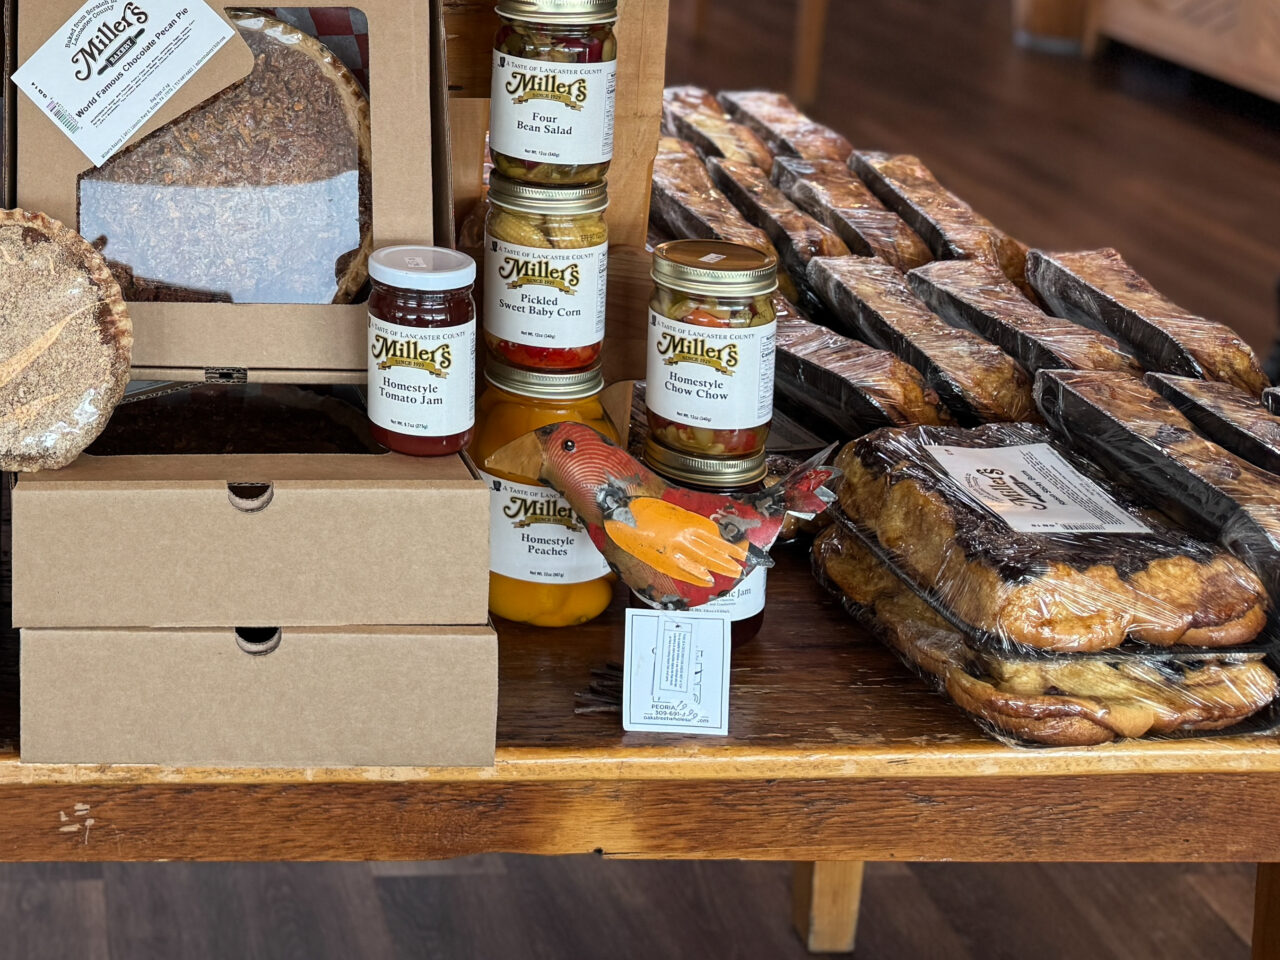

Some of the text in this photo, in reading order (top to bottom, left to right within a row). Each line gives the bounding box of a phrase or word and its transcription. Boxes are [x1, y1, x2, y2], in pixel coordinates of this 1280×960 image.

[65, 0, 109, 48] Baked from Scratch
[72, 4, 114, 46] Lancaster County
[72, 2, 148, 81] Miller's
[109, 40, 132, 62] BAKERY
[75, 7, 189, 119] World Famous Chocolate Pecan Pie
[540, 67, 578, 75] LANCASTER
[505, 72, 587, 102] Miller's
[532, 112, 558, 123] Four
[517, 120, 572, 135] Bean Salad
[499, 257, 580, 287] Miller's
[499, 299, 581, 318] Sweet Baby Corn
[521, 294, 558, 306] Pickled
[400, 332, 441, 340] LANCASTER
[372, 334, 452, 369] Miller's
[657, 332, 738, 367] Miller's
[383, 376, 438, 394] Homestyle
[670, 371, 724, 390] Homestyle
[379, 386, 443, 405] Tomato Jam
[664, 381, 729, 400] Chow Chow
[521, 533, 575, 548] Homestyle
[528, 545, 568, 556] Peaches
[737, 588, 751, 598] Jam
